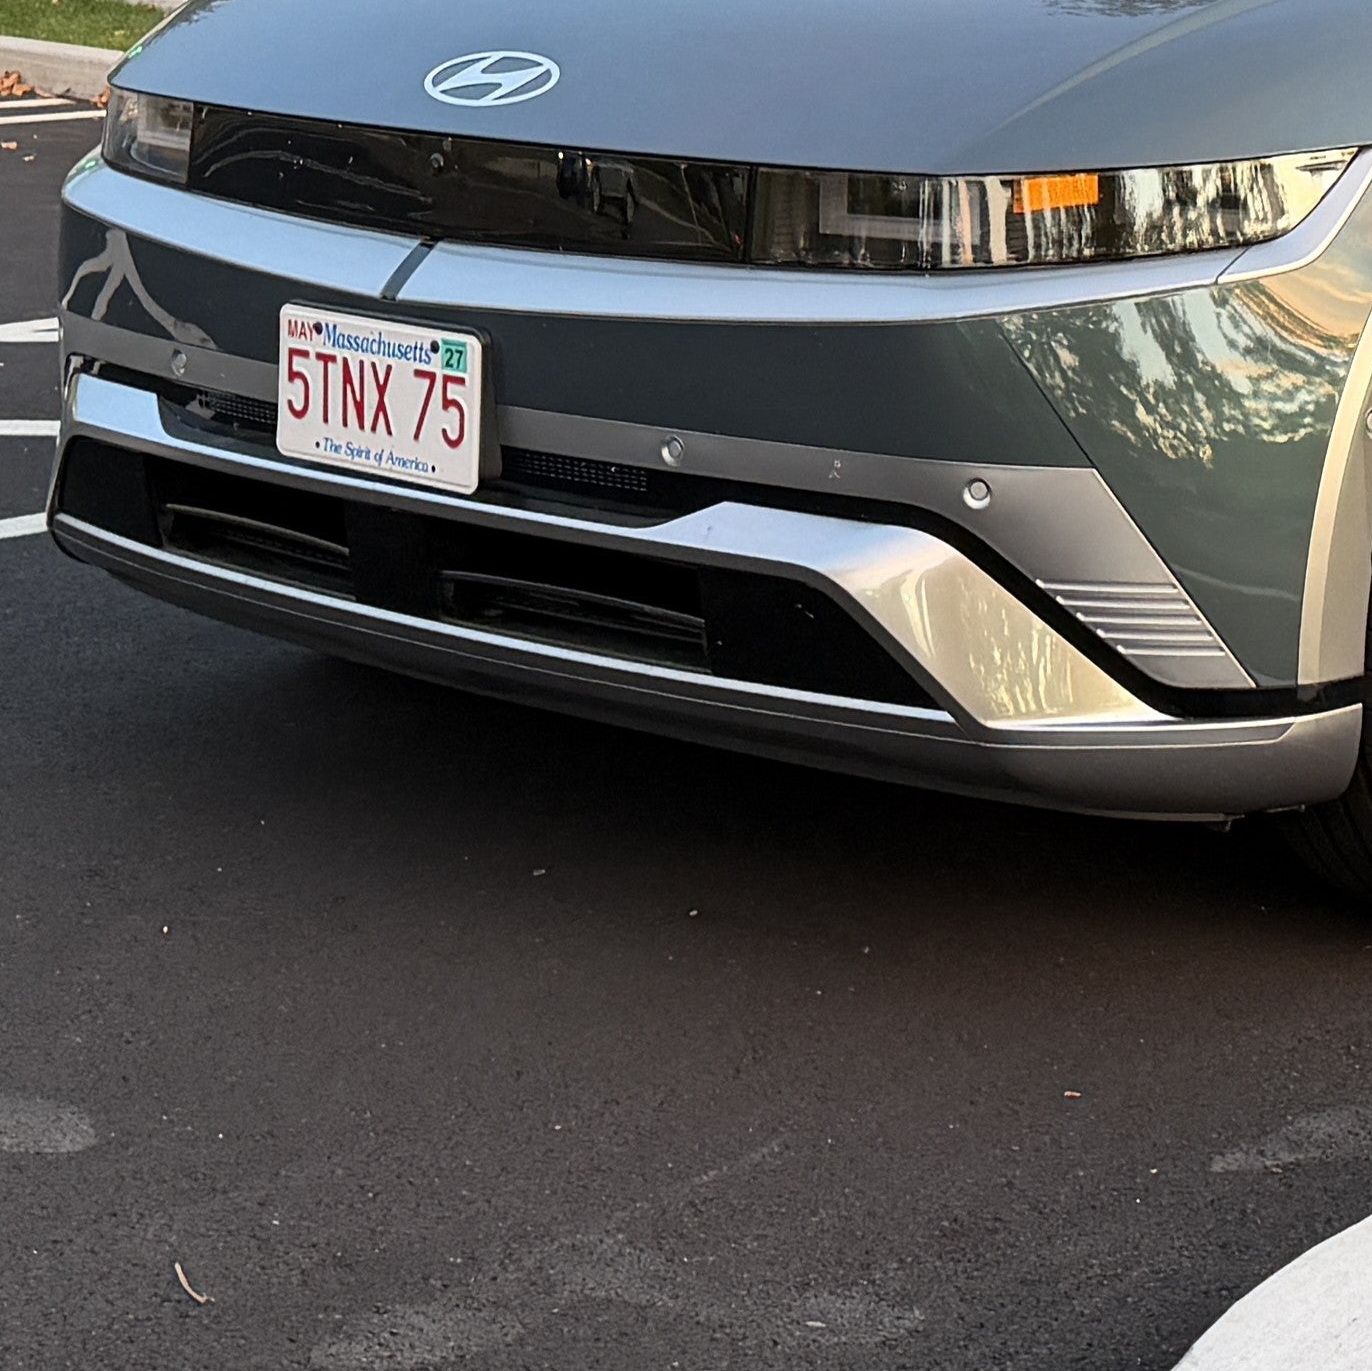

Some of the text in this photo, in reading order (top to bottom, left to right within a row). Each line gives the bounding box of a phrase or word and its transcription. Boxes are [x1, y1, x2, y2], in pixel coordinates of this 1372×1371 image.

[287, 318, 464, 369] MAY Massachusetts 27
[287, 347, 466, 450] 5TNX 75
[323, 437, 429, 473] The Spirit of America
